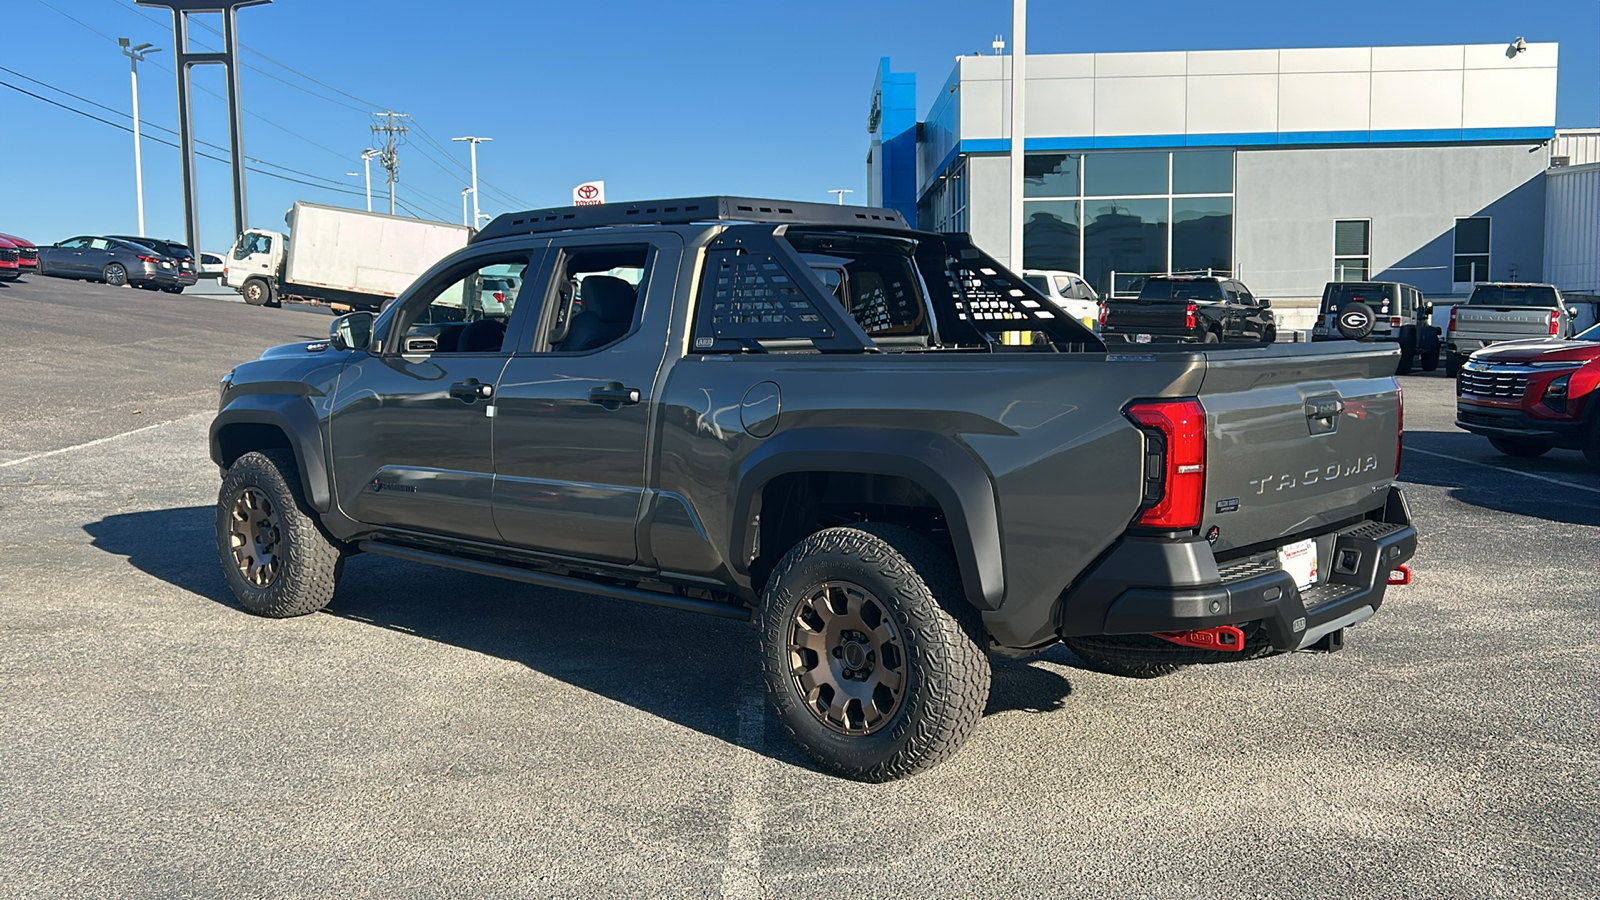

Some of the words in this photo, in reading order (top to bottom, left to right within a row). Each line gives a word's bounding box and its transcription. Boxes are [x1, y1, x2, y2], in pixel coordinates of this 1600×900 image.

[1461, 314, 1541, 322] CHEVROLET
[1249, 453, 1378, 495] TACOMA
[766, 587, 797, 714] WRANGLER
[889, 596, 925, 741] GOODYEAR
